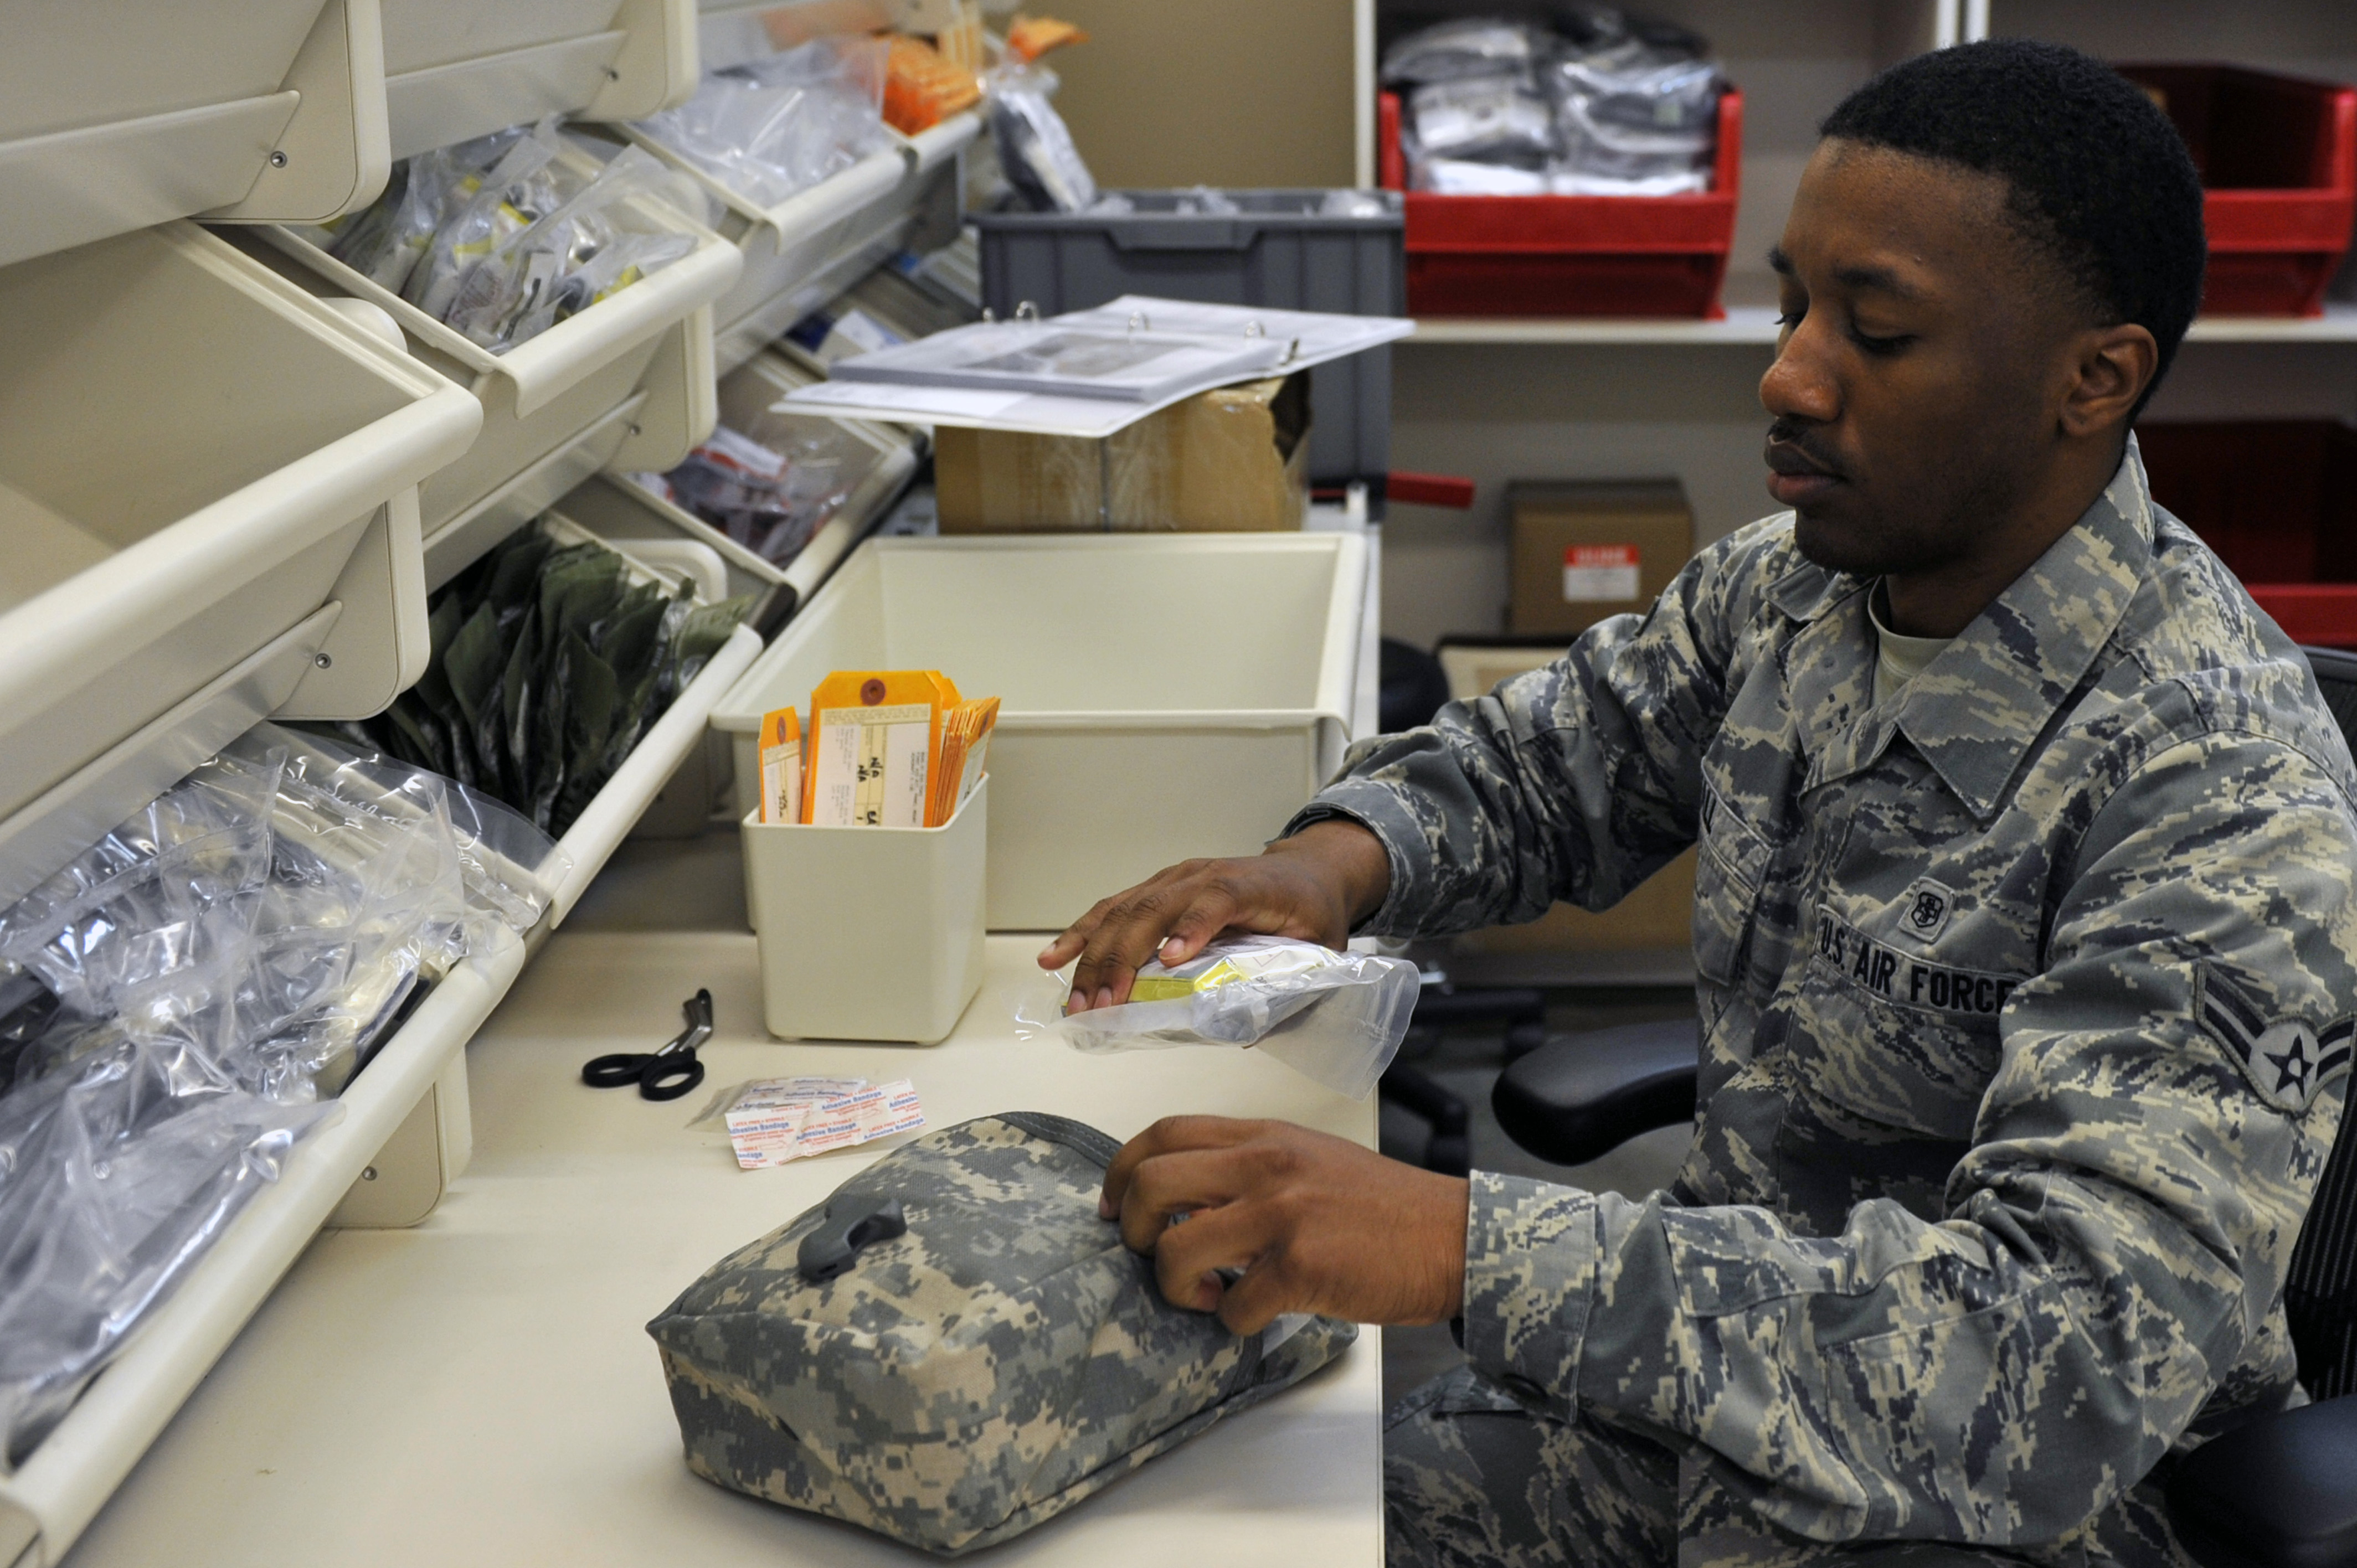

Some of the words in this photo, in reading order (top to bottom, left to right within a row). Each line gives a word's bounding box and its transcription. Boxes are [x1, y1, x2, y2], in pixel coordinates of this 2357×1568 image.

[1854, 941, 1896, 996] AIR
[822, 1099, 852, 1110] Adhesive
[853, 1091, 882, 1102] Bandage
[760, 1122, 789, 1131] Bandage
[827, 1122, 856, 1134] Bandage
[864, 1128, 894, 1140] Adhesive
[895, 1118, 924, 1130] Bandage
